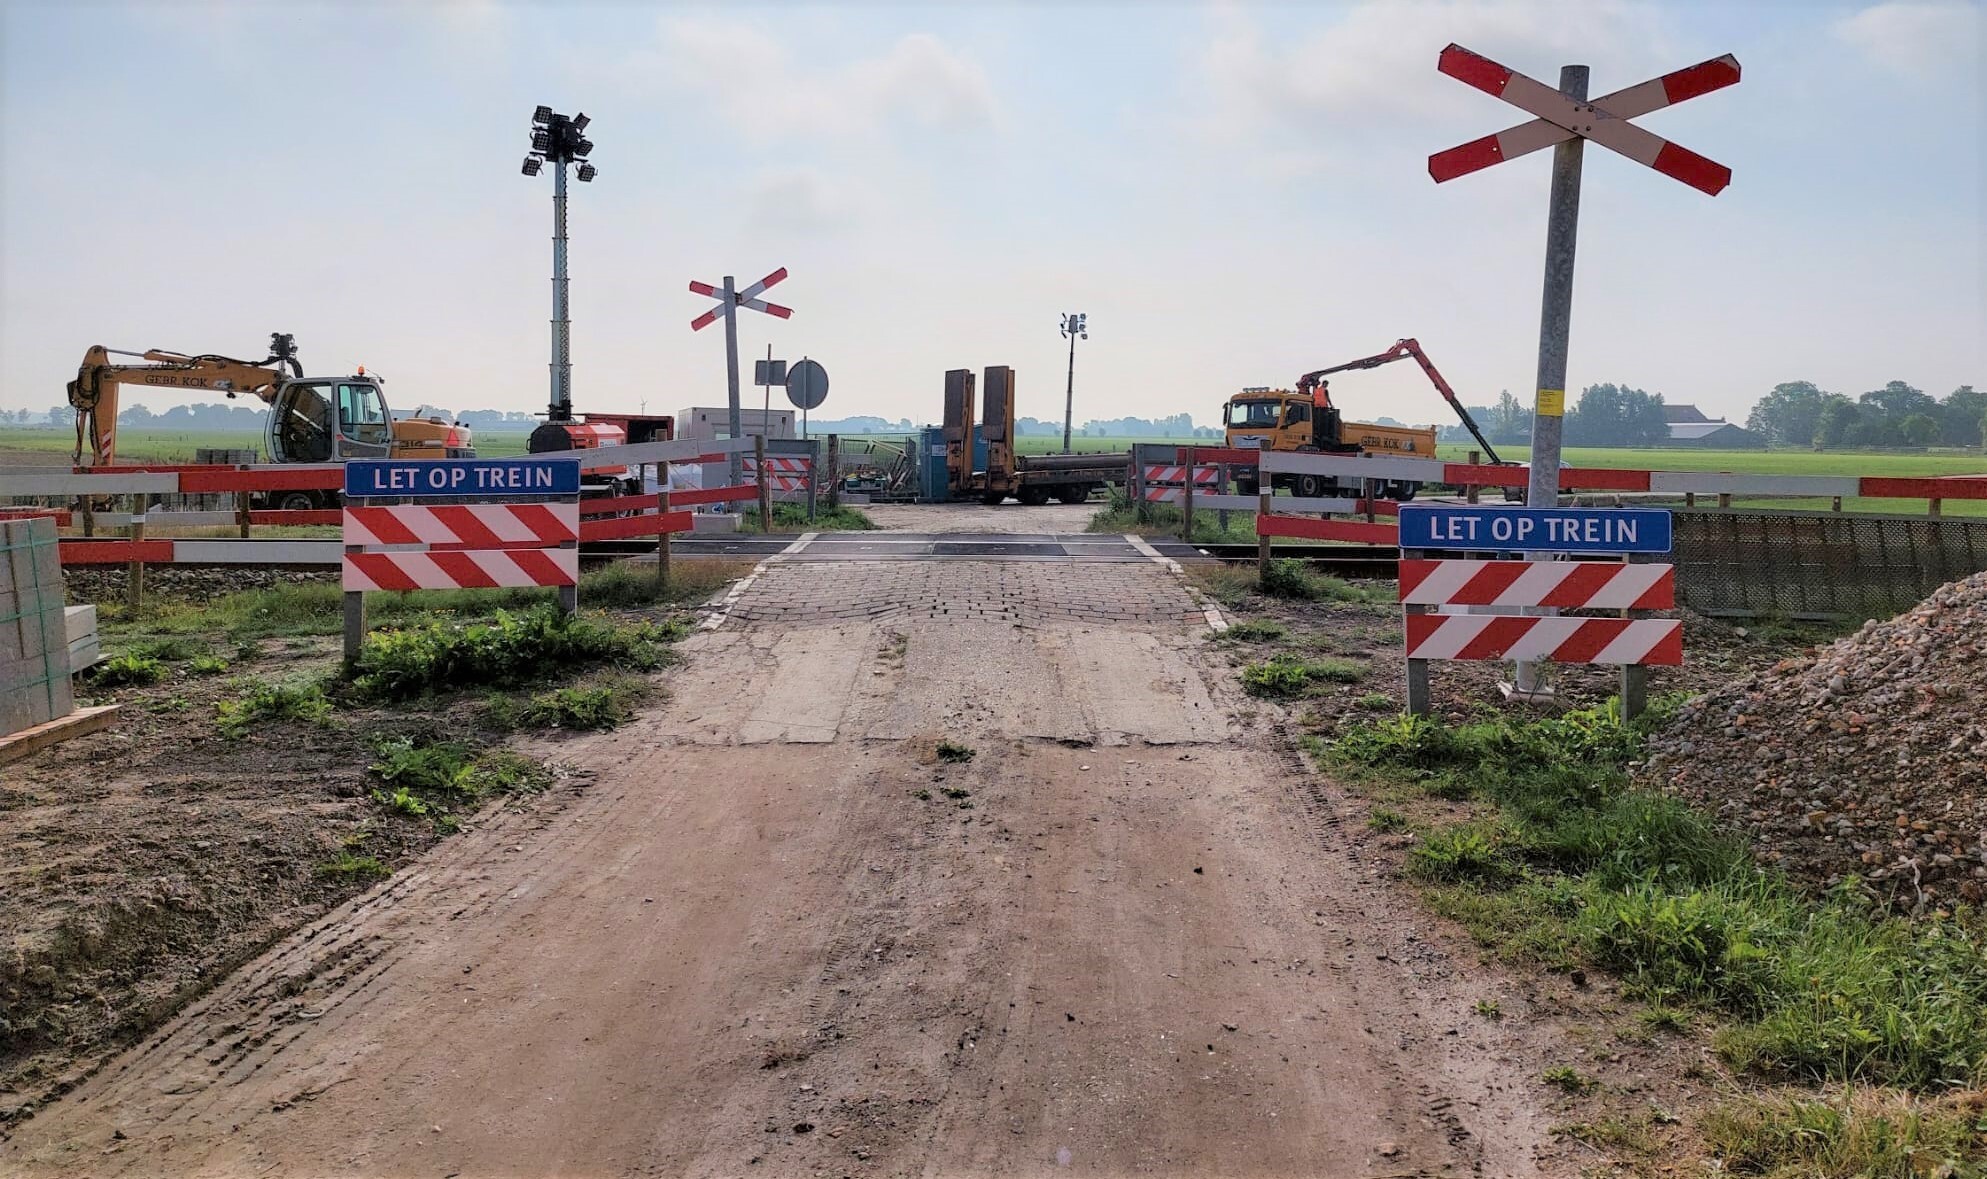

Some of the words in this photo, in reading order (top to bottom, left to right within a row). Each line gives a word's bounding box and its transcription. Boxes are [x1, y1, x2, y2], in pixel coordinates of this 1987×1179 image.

[182, 376, 208, 388] KOK
[1383, 437, 1400, 449] KOK
[374, 467, 420, 489] LET
[428, 467, 466, 489] OP
[474, 467, 553, 488] TREIN
[1430, 515, 1482, 540] LET
[1491, 517, 1534, 541] OP
[1543, 517, 1638, 543] TREIN
